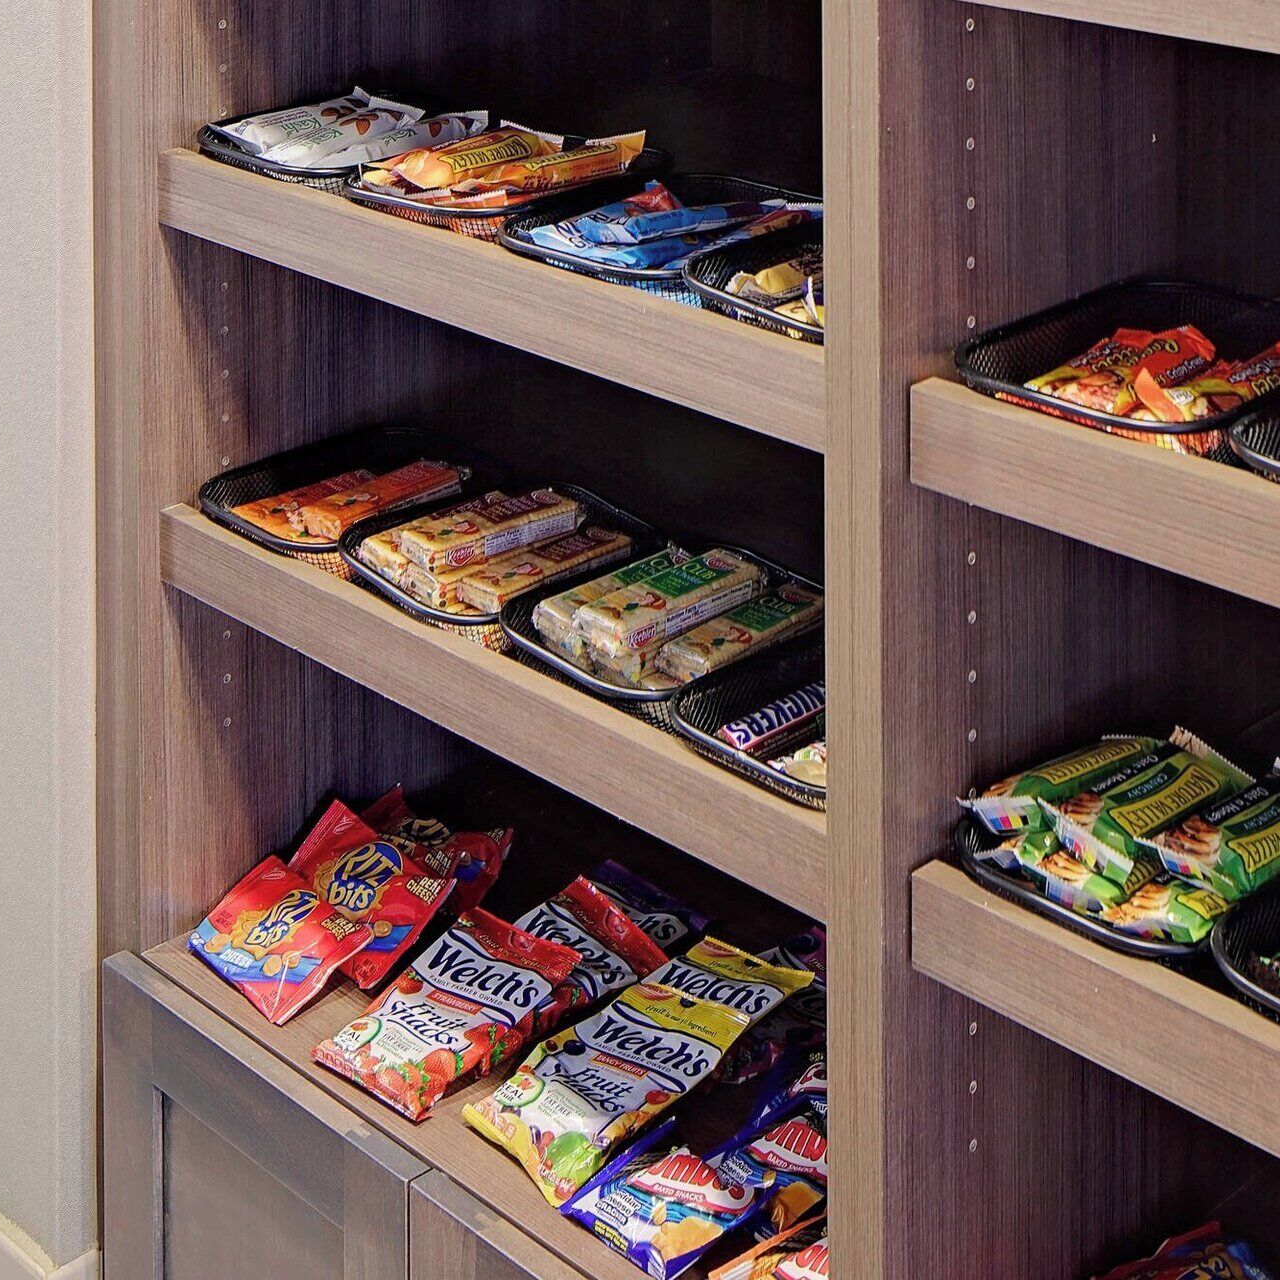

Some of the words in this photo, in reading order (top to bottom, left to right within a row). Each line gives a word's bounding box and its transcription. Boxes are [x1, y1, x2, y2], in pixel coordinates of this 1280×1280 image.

[280, 117, 322, 139] Kashi
[447, 149, 488, 172] VALLEY
[490, 137, 529, 162] NATURE
[628, 625, 656, 645] Keebler
[1126, 772, 1168, 800] CRUNCHY
[1170, 768, 1214, 811] NATURE
[1247, 784, 1269, 802] Oats
[1122, 794, 1172, 832] VALLEY
[1243, 804, 1280, 831] CRUNCHY
[336, 841, 404, 885] RITZ
[328, 882, 373, 910] bits
[406, 880, 437, 906] CHEESE
[419, 876, 445, 896] REAL
[248, 921, 290, 947] bits
[321, 919, 345, 942] CHEESE
[335, 916, 357, 934] REAL
[222, 947, 252, 969] CHEESE
[428, 939, 539, 1008] Welch's
[429, 975, 449, 987] FAMILY
[451, 983, 477, 997] FARMER
[478, 993, 503, 1006] OWNED
[433, 992, 480, 1013] STRAWBERRY
[386, 1000, 459, 1046] Snacks
[407, 1002, 469, 1031] Fruit
[645, 1004, 664, 1016] Fruit
[593, 1014, 709, 1078] Welch's
[595, 1042, 617, 1054] FAMILY
[618, 1050, 644, 1064] FARMER
[646, 1059, 671, 1072] OWNED
[598, 1054, 618, 1068] TANGY
[619, 1061, 646, 1076] FRUITS
[543, 1063, 625, 1113] Snacks
[571, 1066, 634, 1100] Fruit
[767, 1154, 788, 1169] BAKED
[788, 1161, 814, 1174] SNACKS
[653, 1184, 674, 1198] BAKED
[674, 1189, 704, 1203] SNACKS
